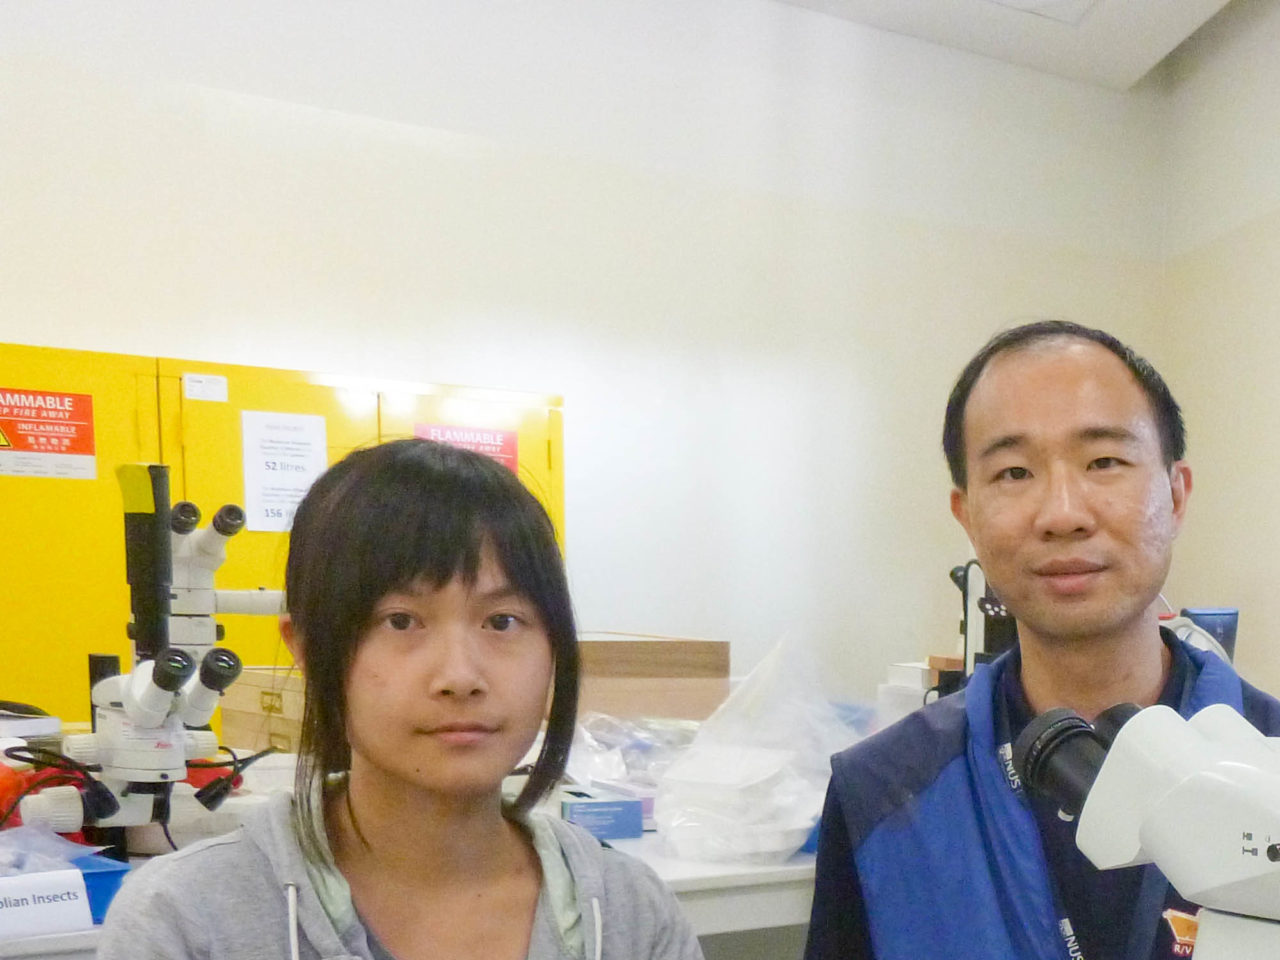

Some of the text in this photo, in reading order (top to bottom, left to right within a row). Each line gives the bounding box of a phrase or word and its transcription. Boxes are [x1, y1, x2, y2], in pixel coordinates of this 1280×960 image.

[14, 408, 37, 417] FIRE
[41, 410, 71, 419] AWAY
[430, 428, 504, 445] FLAMMABLE
[265, 461, 278, 471] 52
[1005, 760, 1021, 789] NUS
[32, 891, 79, 905] Insects
